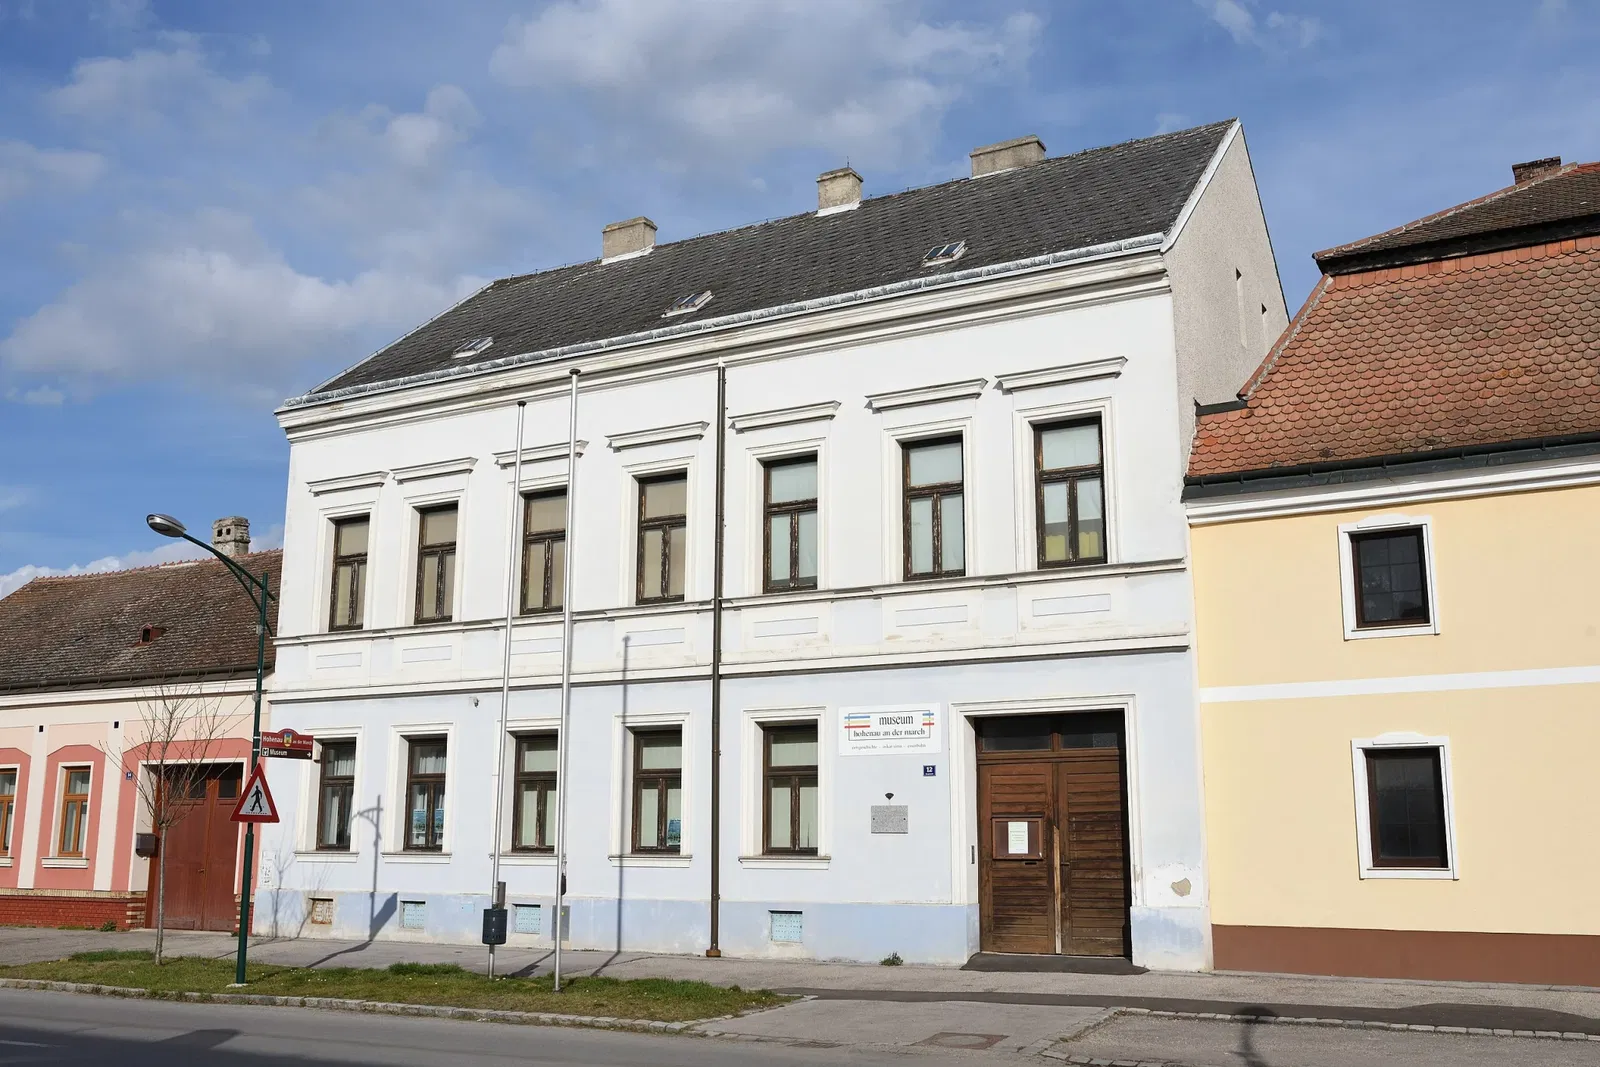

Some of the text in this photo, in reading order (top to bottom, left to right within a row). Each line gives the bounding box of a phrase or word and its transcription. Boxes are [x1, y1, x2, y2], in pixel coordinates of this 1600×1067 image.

[879, 715, 914, 725] museum
[891, 728, 903, 736] der
[904, 728, 925, 736] march
